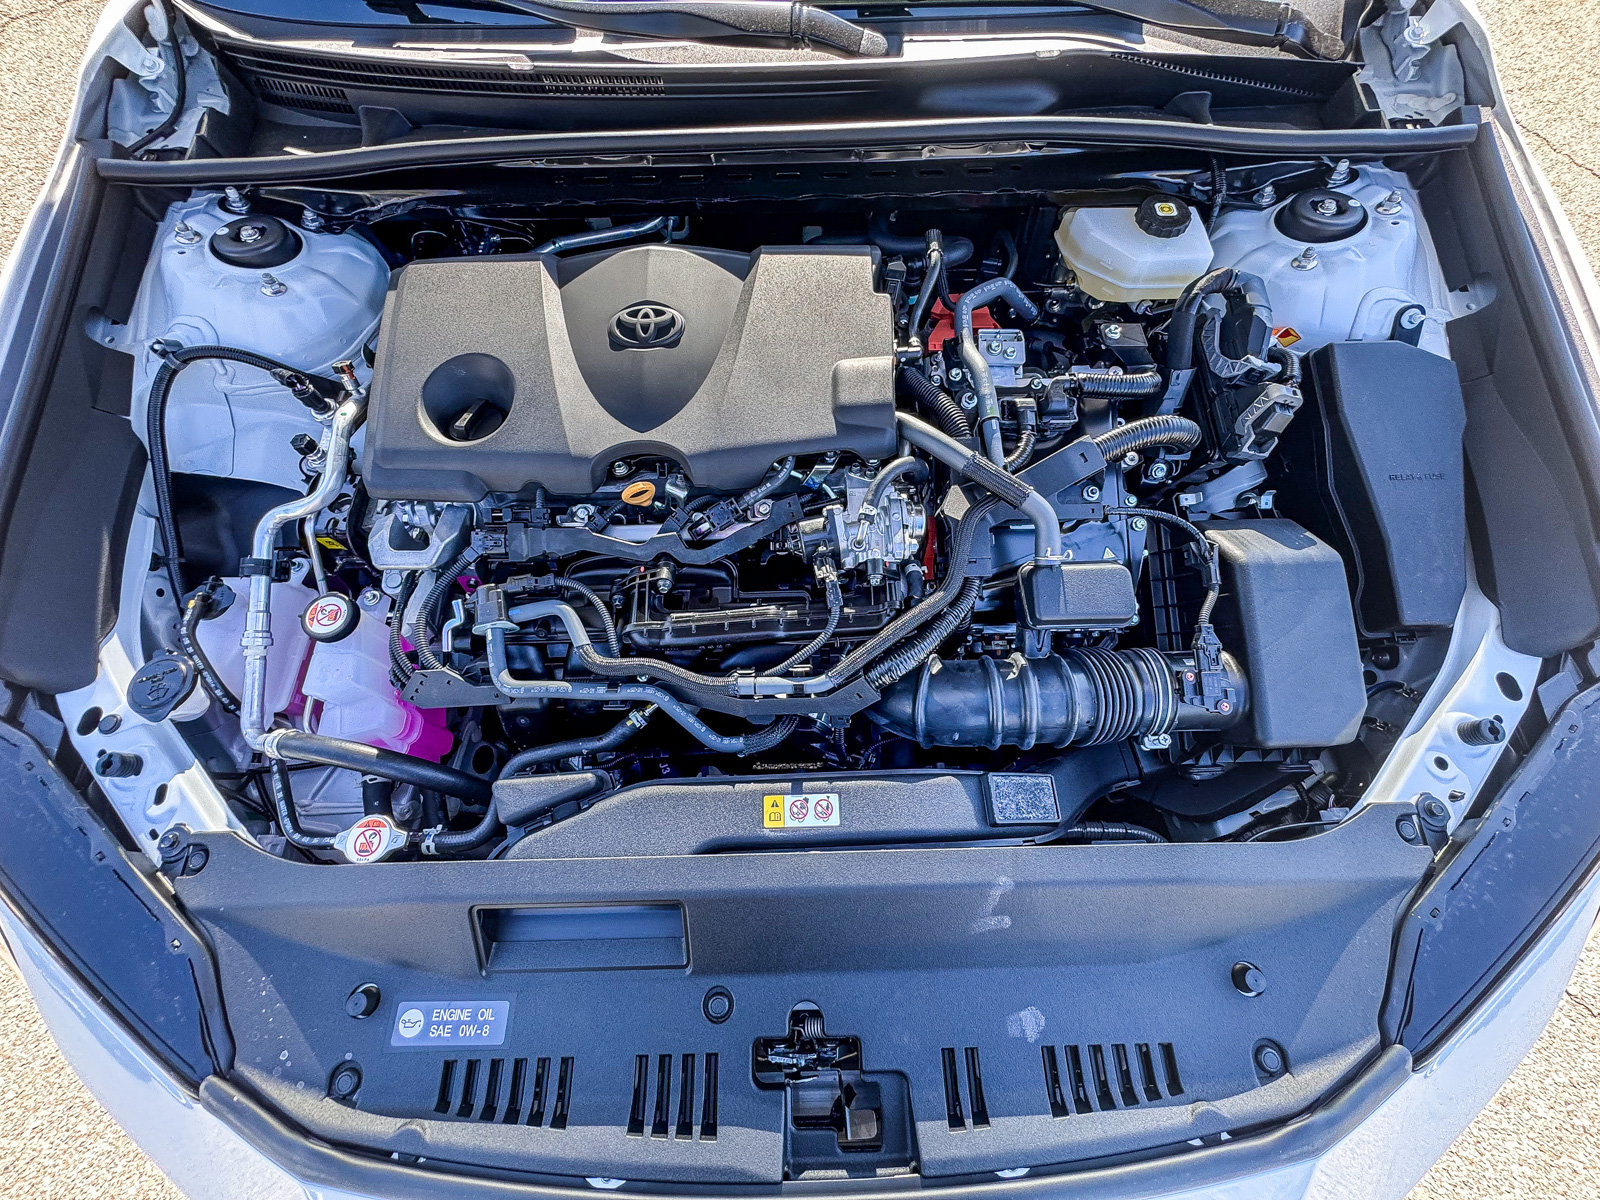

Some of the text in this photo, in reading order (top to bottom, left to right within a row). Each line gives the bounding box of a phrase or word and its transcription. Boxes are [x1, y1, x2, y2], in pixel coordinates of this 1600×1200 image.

[432, 1008, 495, 1021] ENGINE OIL
[429, 1024, 490, 1037] SAE 0W-8
